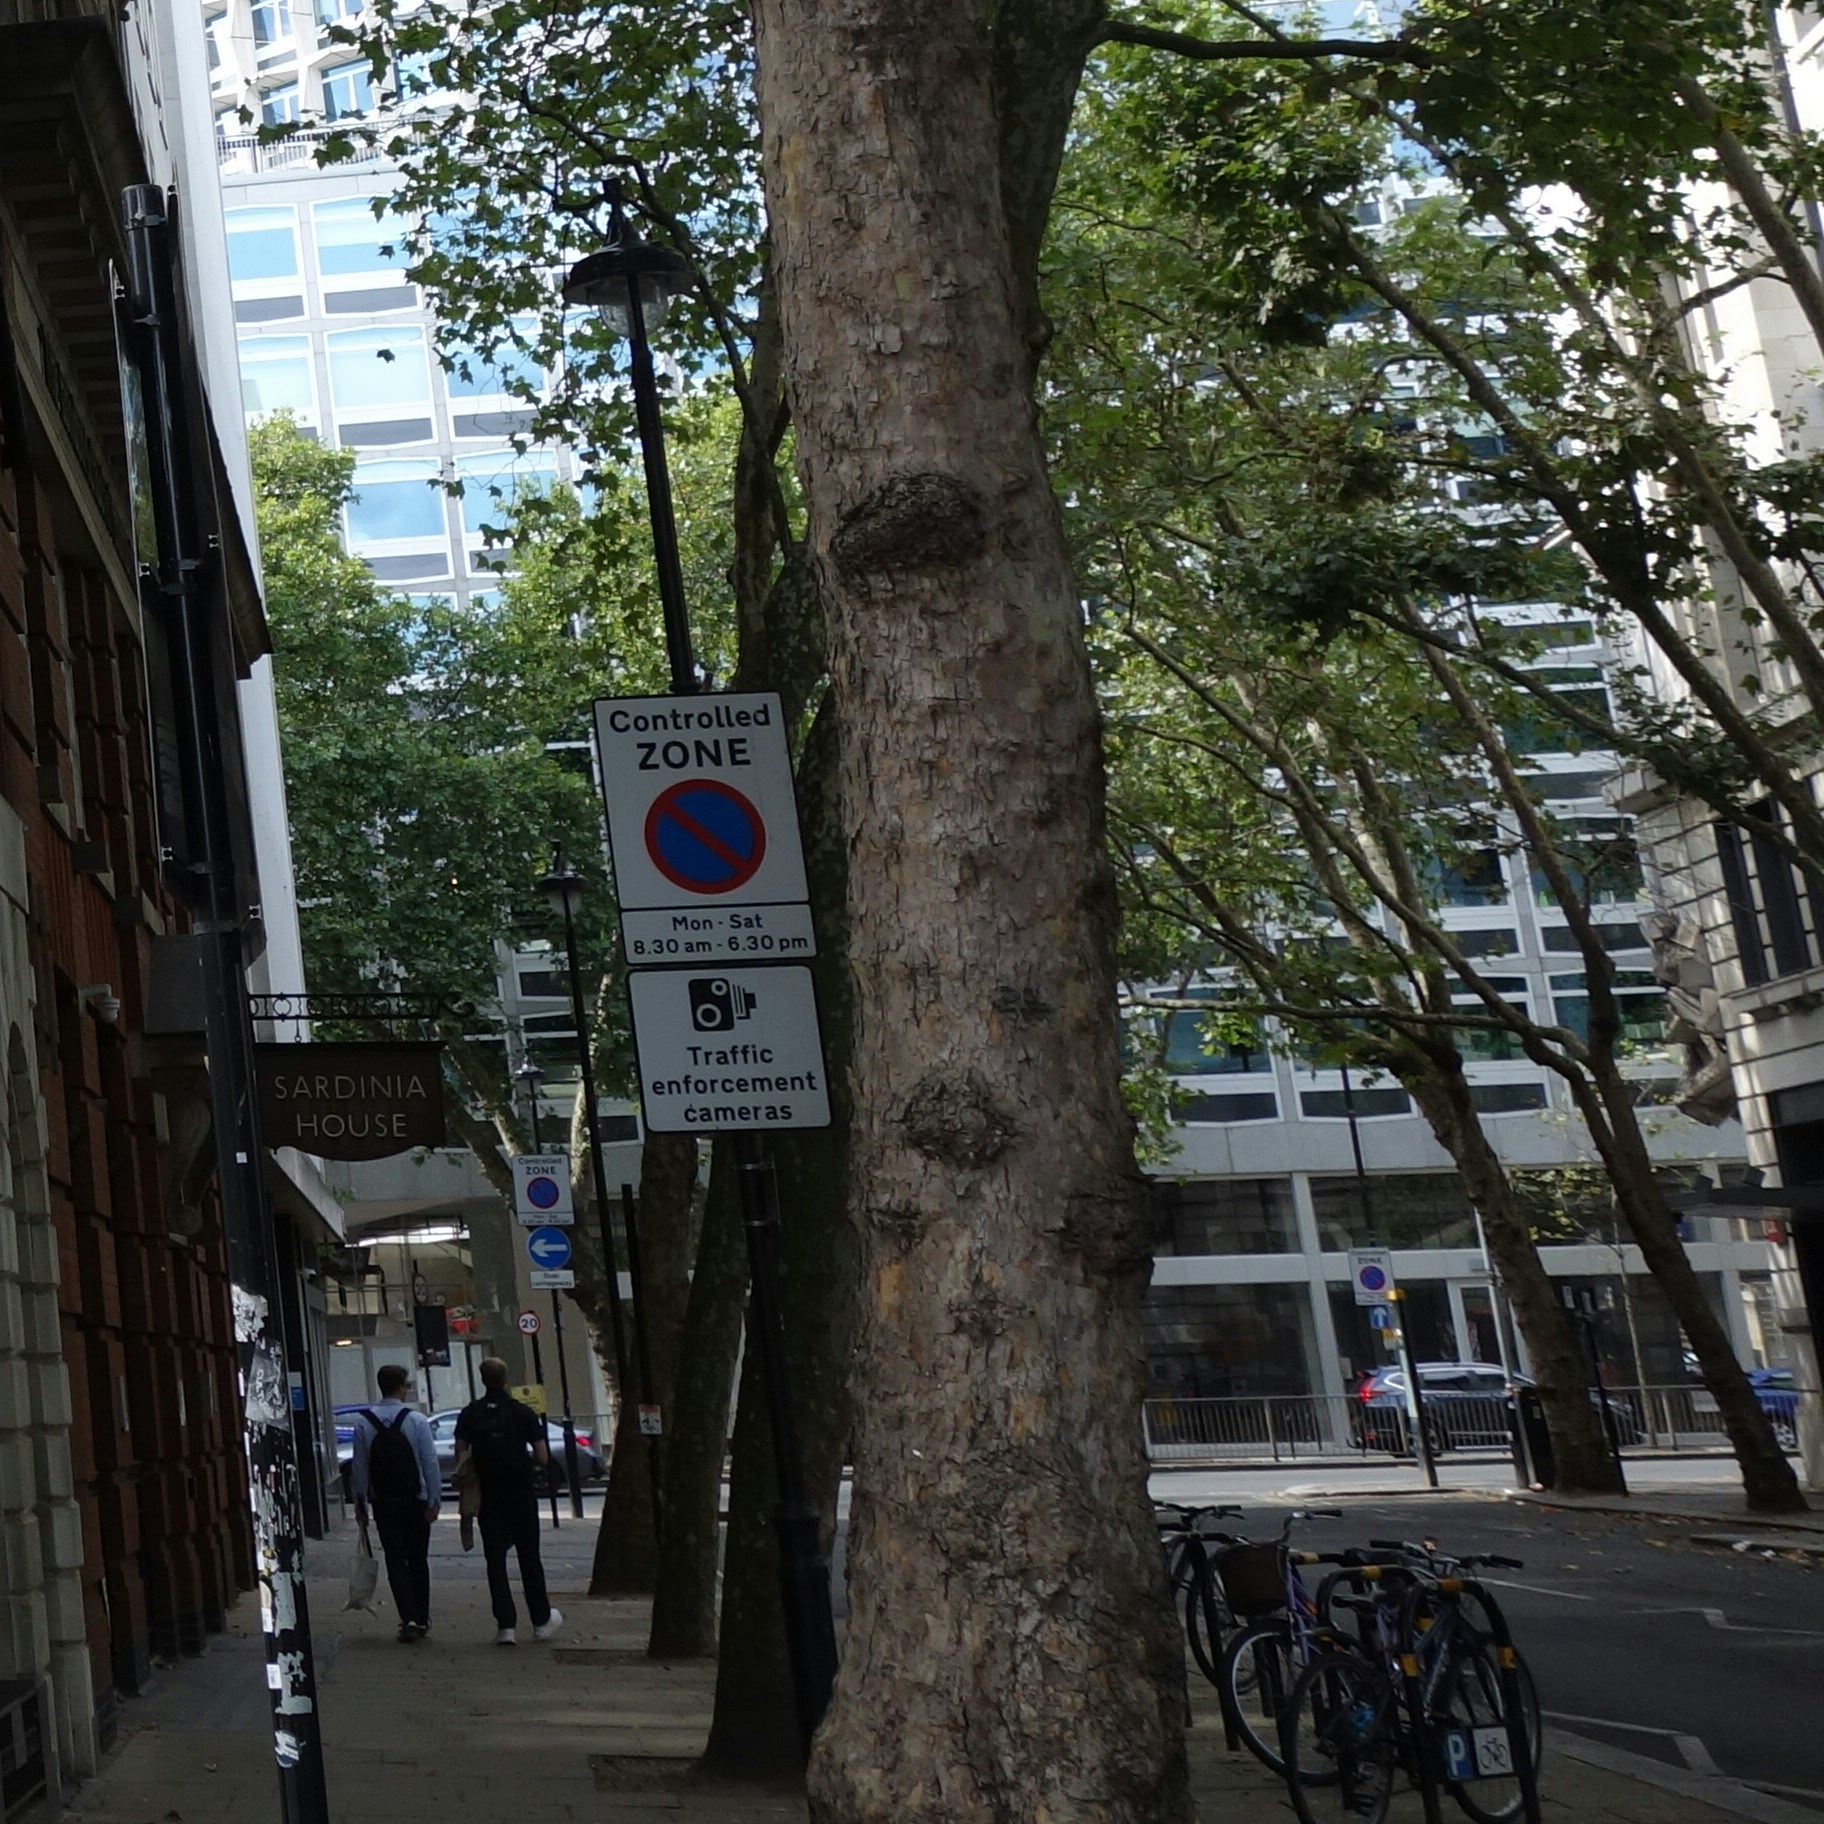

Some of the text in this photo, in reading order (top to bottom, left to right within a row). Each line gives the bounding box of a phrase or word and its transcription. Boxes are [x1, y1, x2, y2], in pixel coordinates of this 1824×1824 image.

[609, 703, 771, 734] Controlled
[637, 738, 752, 771] ZONE
[672, 915, 714, 933] Mon
[729, 914, 763, 930] Sat
[633, 939, 679, 956] 8.30
[684, 940, 713, 953] am
[727, 935, 775, 952] 6.30
[779, 936, 809, 953] pm
[686, 1044, 774, 1066] Traffic
[273, 1075, 427, 1099] SARDINIA
[652, 1071, 818, 1096] enforcement
[684, 1102, 793, 1124] cameras
[296, 1114, 408, 1138] HOUSE
[525, 1165, 557, 1175] ZONE
[521, 1318, 537, 1329] 20
[1447, 1733, 1466, 1777] P
